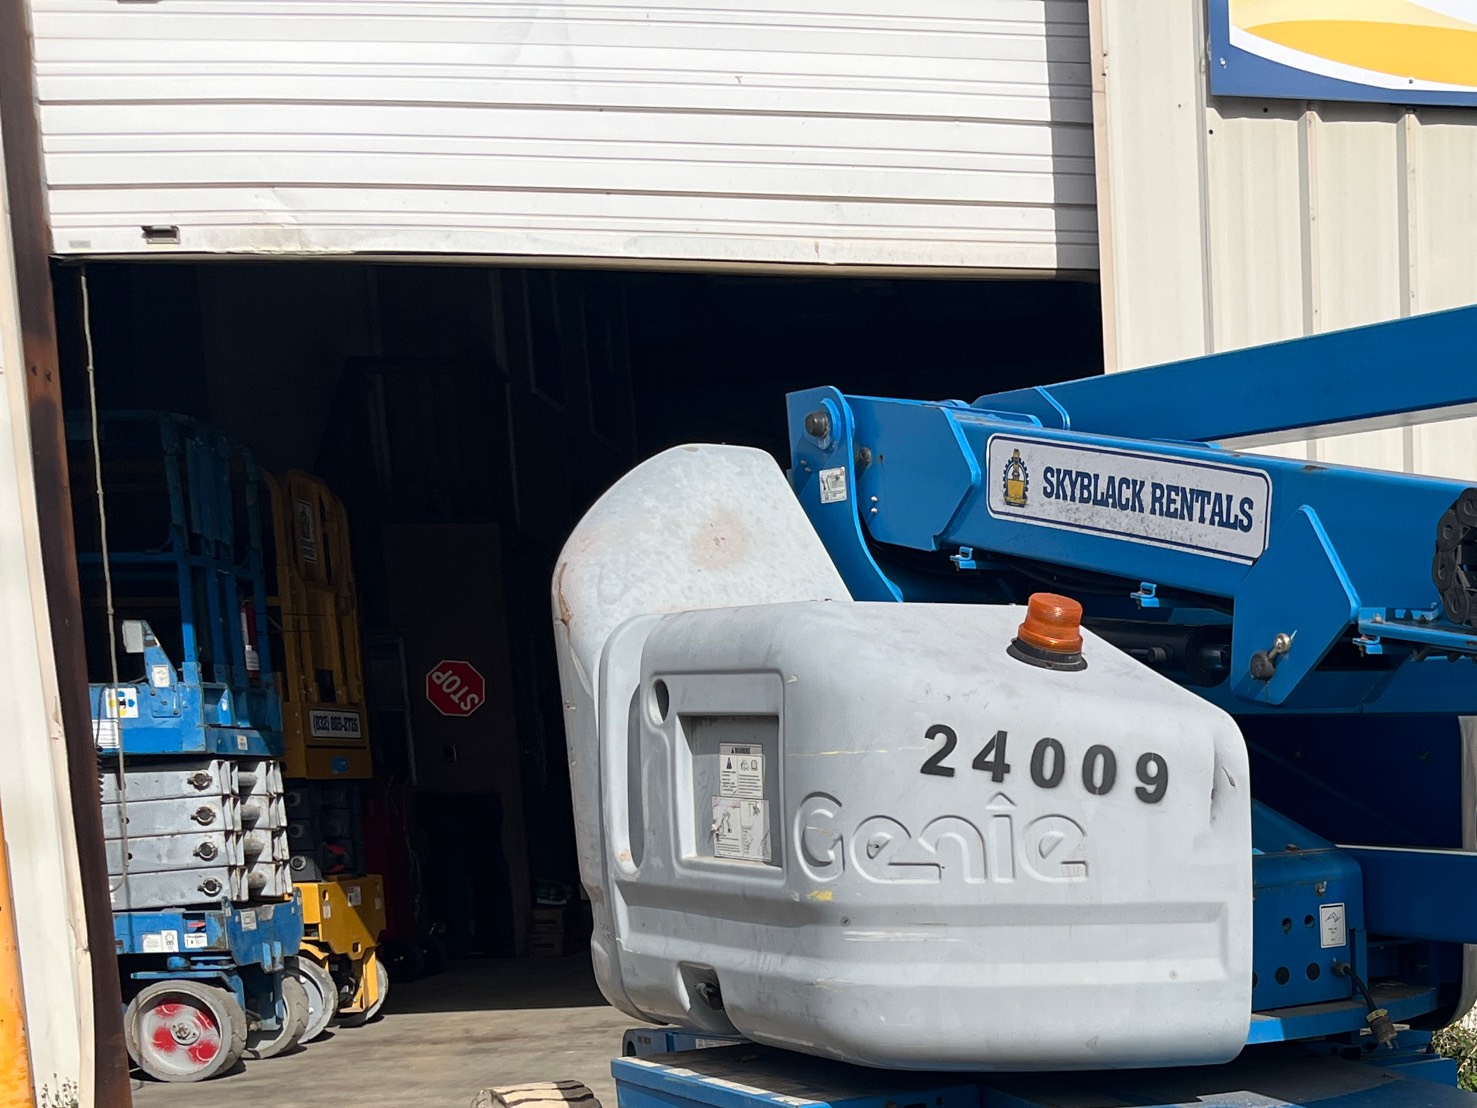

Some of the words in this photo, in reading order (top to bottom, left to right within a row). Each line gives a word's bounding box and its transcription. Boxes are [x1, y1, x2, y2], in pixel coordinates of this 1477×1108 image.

[1042, 466, 1146, 513] SKYBLACK
[1149, 482, 1255, 533] RENTALS
[432, 670, 479, 711] STOP
[920, 724, 1169, 804] 24009
[793, 791, 1089, 885] Genie
